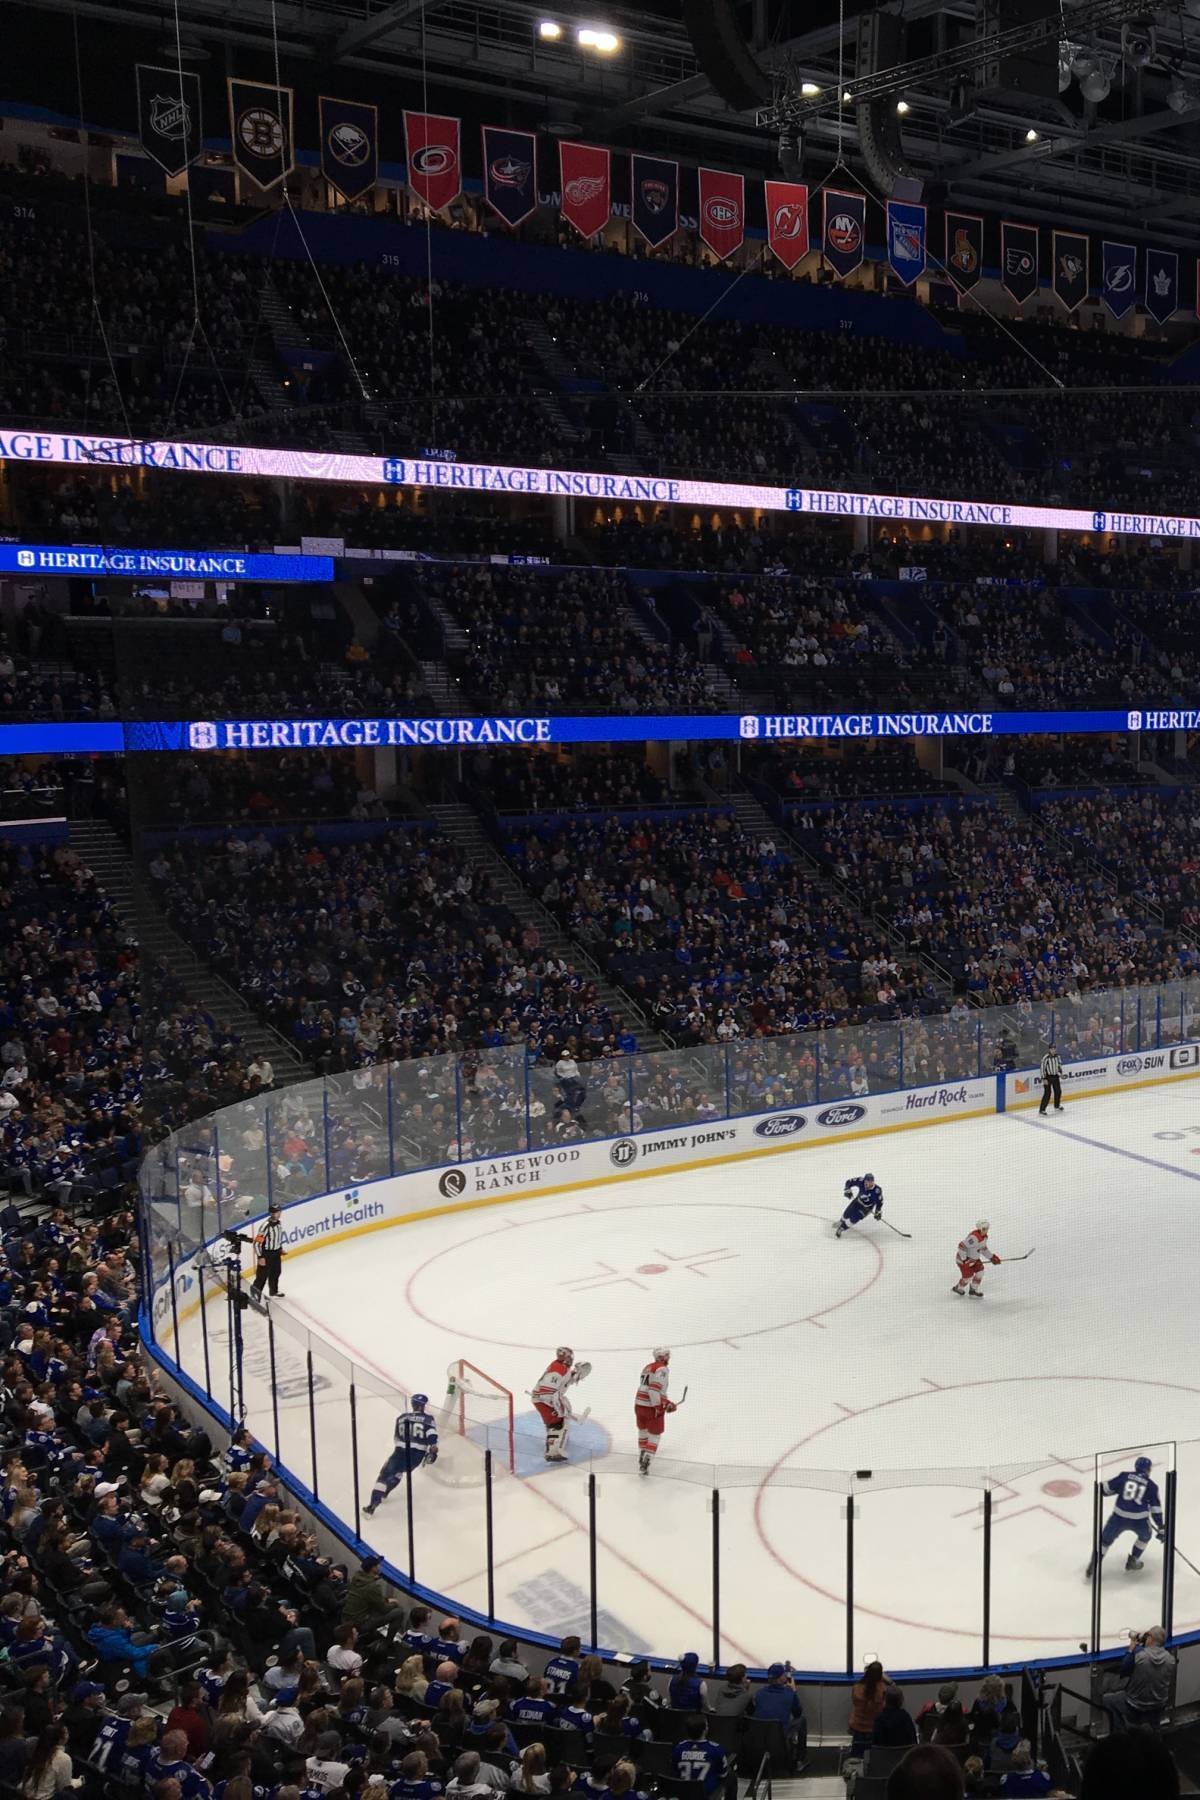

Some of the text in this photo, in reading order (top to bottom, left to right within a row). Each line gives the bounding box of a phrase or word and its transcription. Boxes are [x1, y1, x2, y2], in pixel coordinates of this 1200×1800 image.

[159, 107, 184, 128] NHL
[13, 206, 36, 219] 314
[381, 254, 400, 266] 315
[633, 292, 649, 302] 316
[63, 438, 242, 471] INSURANCE
[414, 463, 681, 501] HERITAGE INSURANCE
[808, 493, 1012, 524] HERITAGE INSURANCE
[1110, 515, 1185, 536] HERITAGE
[39, 551, 245, 573] HERITAGE INSURANCE
[225, 719, 551, 748] HERITAGE INSURANCE
[764, 714, 993, 737] HERITAGE INSURANCE
[1121, 1060, 1137, 1070] FOX
[1144, 1056, 1164, 1070] SUN
[906, 1091, 938, 1110] Hard
[938, 1086, 967, 1106] Rock
[762, 1116, 801, 1135] Ford
[825, 1107, 860, 1126] Ford
[642, 1128, 737, 1157] JIMMY JOHN'S
[475, 1150, 581, 1178] LAKEWOOD
[475, 1170, 541, 1192] RANCH
[1123, 1480, 1146, 1504] 81
[677, 1761, 711, 1782] 37
